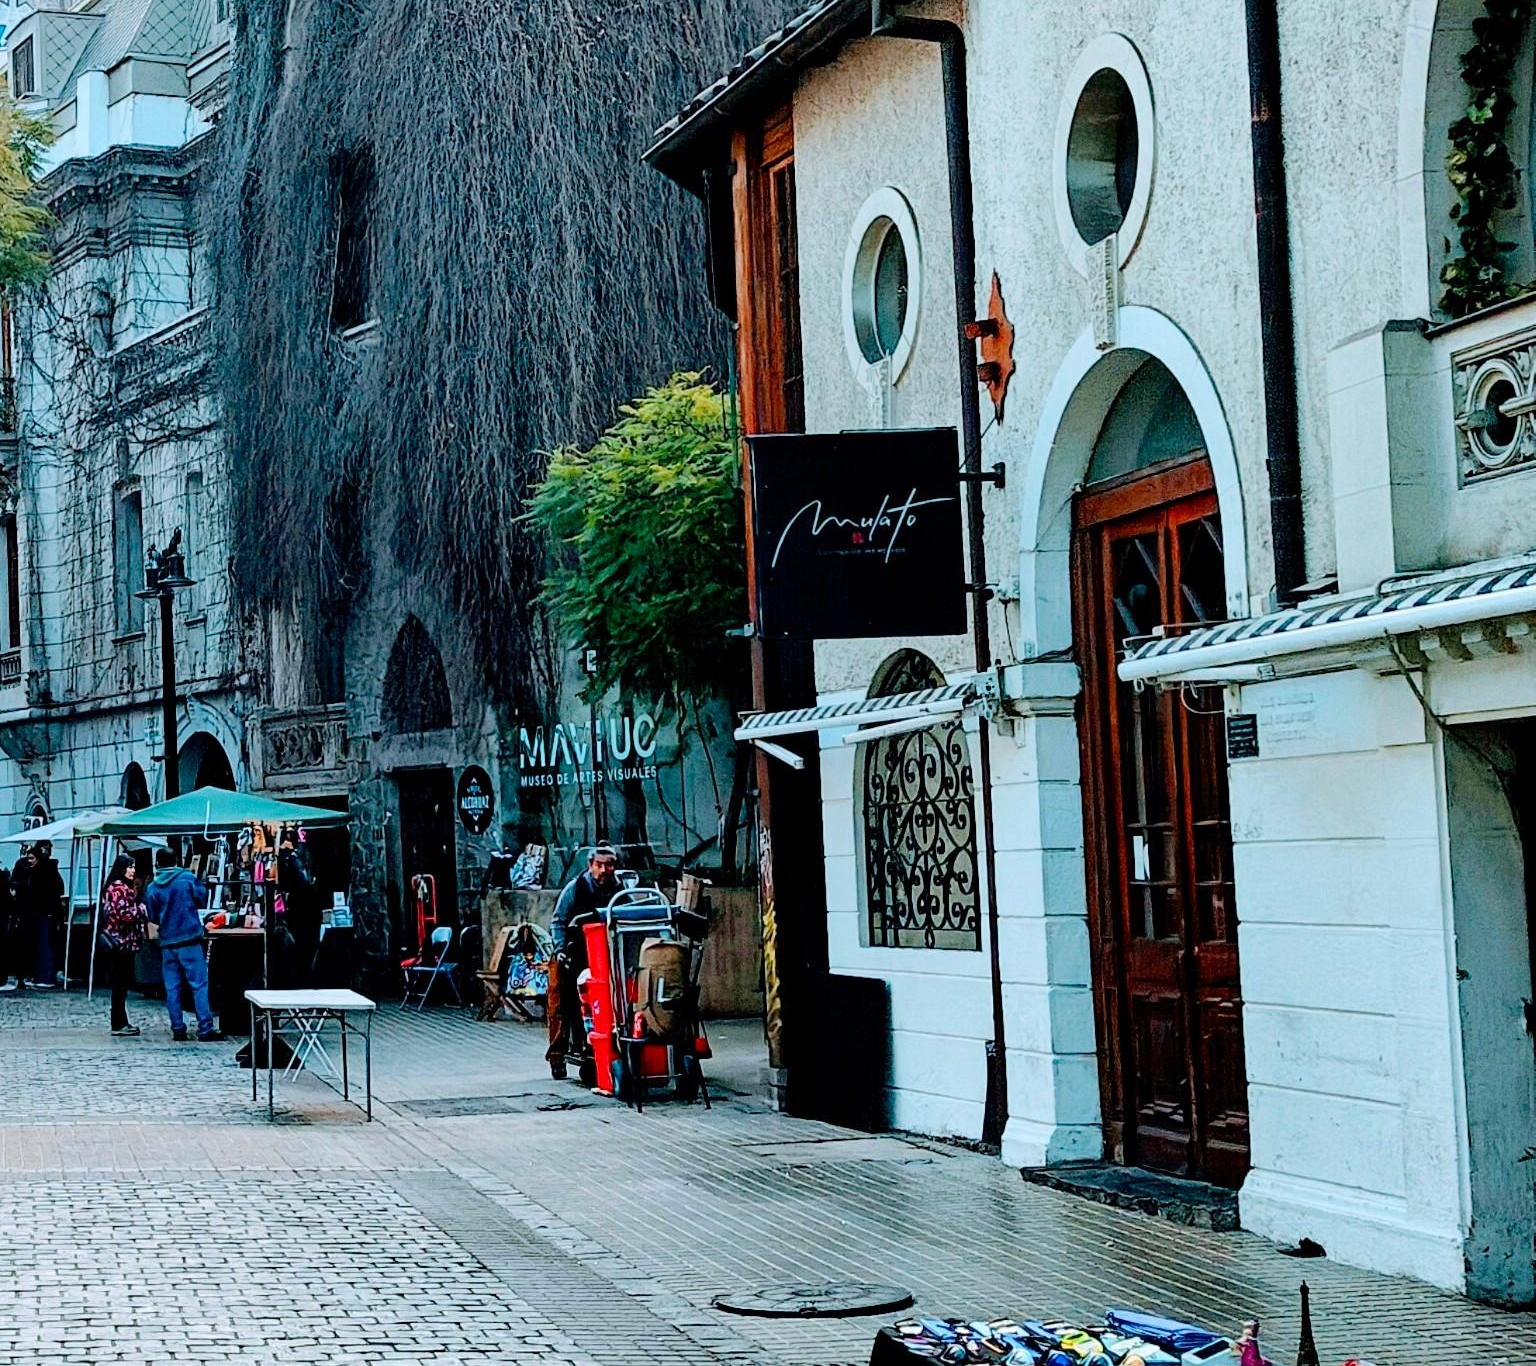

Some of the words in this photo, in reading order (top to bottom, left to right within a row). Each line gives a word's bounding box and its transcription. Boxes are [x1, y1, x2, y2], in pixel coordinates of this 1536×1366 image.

[771, 488, 956, 568] Mulato
[521, 774, 553, 787] MUSEO
[557, 772, 569, 784] DE
[572, 770, 603, 784] ARTES
[607, 766, 657, 781] VISUALES
